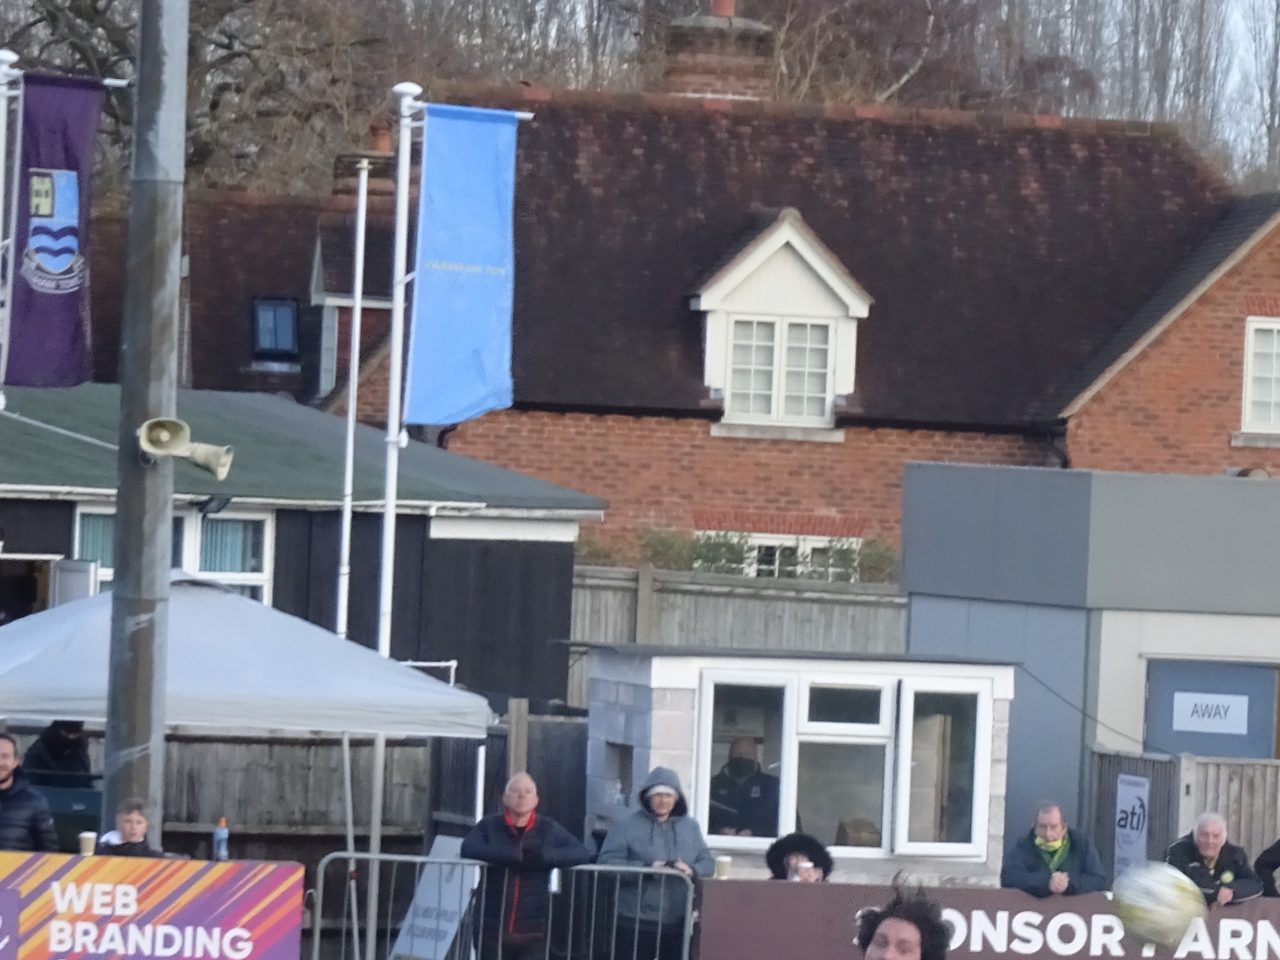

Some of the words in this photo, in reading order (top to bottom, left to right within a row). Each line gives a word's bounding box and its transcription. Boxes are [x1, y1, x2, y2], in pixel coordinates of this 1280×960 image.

[1190, 703, 1230, 720] AWAY
[51, 881, 139, 916] WEB
[48, 920, 252, 960] BRANDING
[852, 906, 1126, 957] ONSOR
